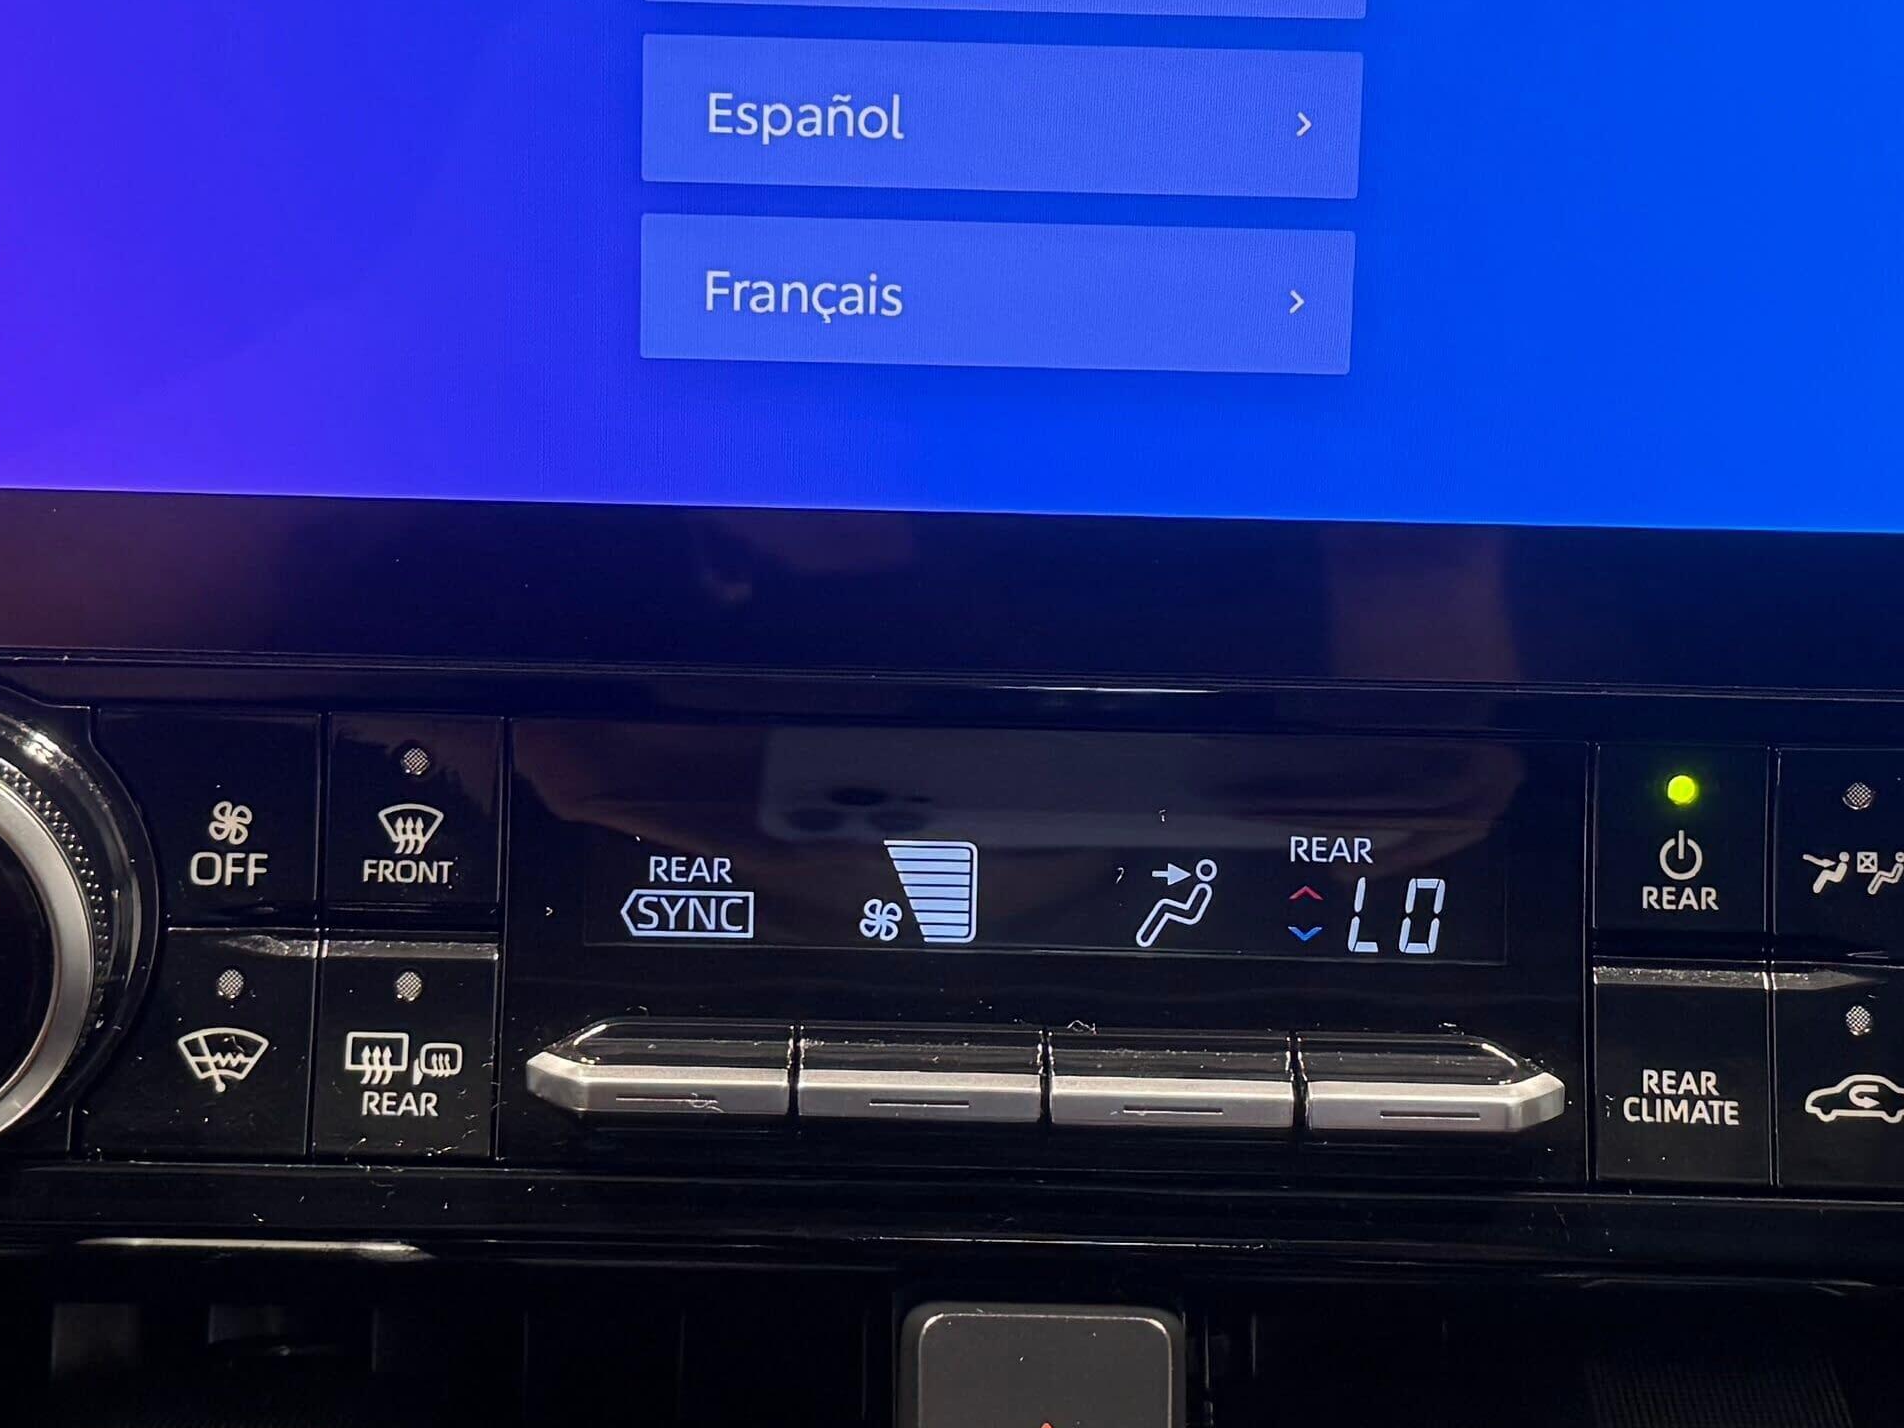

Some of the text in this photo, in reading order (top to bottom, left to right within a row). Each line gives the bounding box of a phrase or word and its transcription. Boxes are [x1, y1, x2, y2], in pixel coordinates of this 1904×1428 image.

[707, 92, 904, 145] Español
[704, 270, 903, 323] Français
[1290, 835, 1373, 865] REAR
[190, 852, 268, 886] OFF
[363, 860, 453, 883] FRONT
[649, 856, 733, 883] REAR
[1642, 886, 1719, 911] REAR
[637, 896, 744, 932] SYNC
[1642, 1069, 1719, 1096] REAR
[361, 1092, 439, 1116] REAR
[1623, 1097, 1739, 1126] CLIMATE
